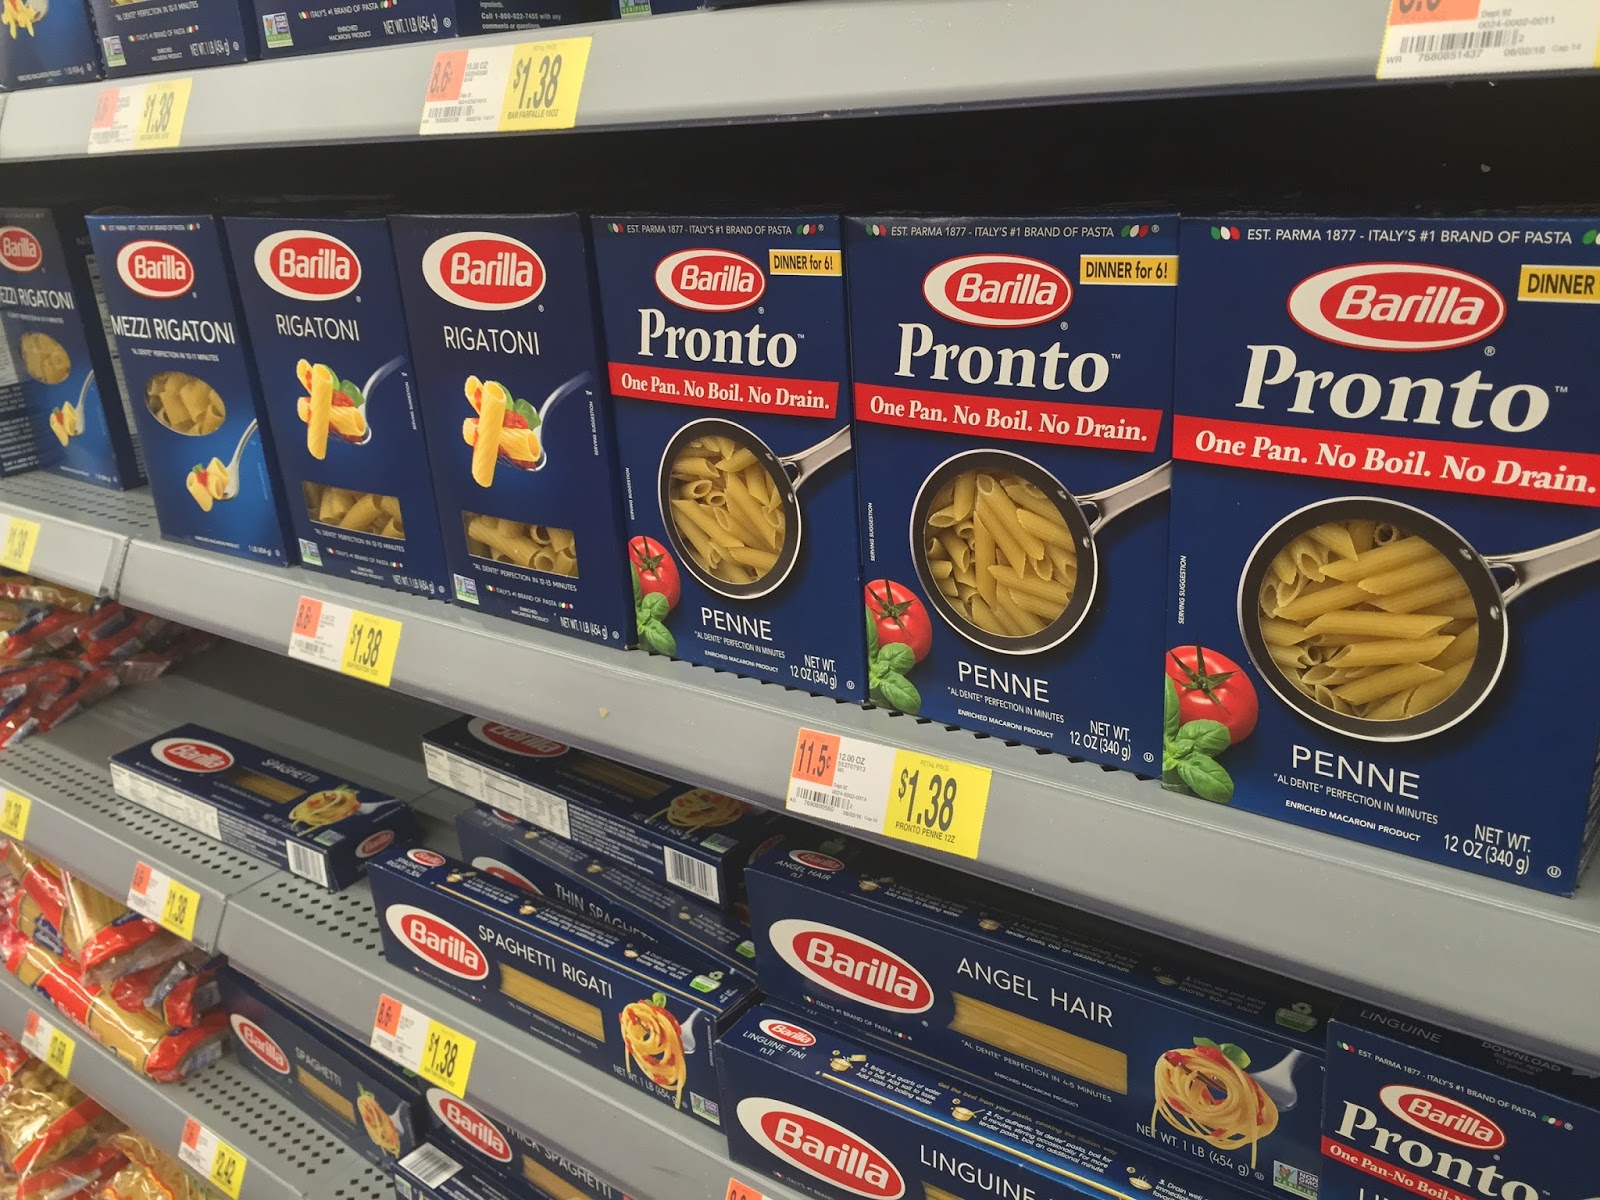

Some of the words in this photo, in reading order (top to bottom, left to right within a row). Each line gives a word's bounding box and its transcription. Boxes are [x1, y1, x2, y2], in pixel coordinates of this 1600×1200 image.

[513, 54, 562, 109] $1.38
[519, 109, 545, 119] FARFALLE
[626, 224, 641, 234] EST.
[641, 224, 667, 234] PARMA
[668, 225, 684, 234] 1877
[689, 224, 714, 235] ITALY'S
[715, 225, 724, 234] #1
[725, 225, 754, 235] BRAND
[755, 225, 766, 235] OF
[768, 225, 792, 235] PASTA
[891, 226, 910, 237] EST.
[911, 226, 943, 237] PARMA
[946, 226, 967, 237] 1877
[974, 226, 1008, 238] ITALY'S
[1009, 226, 1022, 238] #1
[1024, 226, 1062, 238] BRAND
[1064, 226, 1079, 238] OF
[1081, 226, 1114, 238] PASTA
[1247, 228, 1273, 242] EST.
[1275, 228, 1322, 241] PARMA
[1326, 228, 1356, 242] 1877
[1368, 229, 1416, 243] ITALY'S
[1419, 229, 1436, 243] #1
[1441, 230, 1494, 244] BRAND
[1498, 230, 1521, 244] OF
[1524, 231, 1572, 245] PASTA
[2, 238, 37, 258] Barilla
[279, 248, 351, 281] Barilla
[773, 255, 808, 270] DINNER
[809, 256, 822, 270] for
[824, 257, 834, 271] 6!
[134, 255, 187, 280] Barilla
[450, 251, 534, 287] Barilla
[680, 264, 756, 293] Barilla
[1086, 261, 1132, 278] DINNER
[1135, 262, 1153, 279] for
[1155, 262, 1168, 279] 6!
[1527, 273, 1595, 295] DINNER
[0, 286, 18, 305] EZZI
[18, 289, 75, 310] RIGATONI
[956, 273, 1059, 306] Barilla
[1336, 284, 1485, 326] Barilla
[110, 315, 151, 339] MEZZI
[155, 319, 236, 344] RIGATONI
[276, 313, 360, 342] RIGATONI
[443, 325, 540, 355] RIGATONI
[638, 308, 798, 368] Pronto
[894, 322, 1110, 393] Pronto
[621, 373, 648, 391] One
[650, 376, 680, 395] Pan.
[683, 380, 705, 398] No
[708, 382, 744, 402] Boil.
[748, 386, 772, 405] No
[775, 388, 830, 410] Drain.
[1235, 344, 1550, 433] Pronto
[870, 395, 905, 417] One
[909, 400, 948, 422] Pan.
[953, 405, 981, 426] No
[984, 408, 1033, 431] Boil.
[1039, 413, 1070, 435] No
[1075, 416, 1148, 442] Drain.
[1195, 430, 1246, 456] One
[1251, 436, 1308, 464] Pan.
[1315, 442, 1356, 469] No
[1362, 448, 1431, 477] Boil.
[1439, 455, 1486, 483] No
[1492, 459, 1596, 494] Drain.
[1179, 555, 1187, 597] SUGGESTION
[700, 606, 773, 642] PENNE
[1177, 598, 1185, 624] SERVING
[350, 624, 383, 668] $1.38
[957, 661, 1050, 703] PENNE
[1070, 730, 1081, 747] 12
[1083, 734, 1098, 751] OZ
[1099, 737, 1120, 757] (340
[1122, 742, 1132, 762] g)
[1090, 720, 1109, 737] NET
[1113, 725, 1131, 743] WT.
[262, 758, 321, 784] SPAGHETTI
[839, 752, 855, 763] 12.00
[856, 756, 866, 765] OZ
[920, 759, 935, 769] RETAIL
[936, 762, 950, 772] PRICE
[1291, 744, 1420, 800] PENNE
[898, 767, 957, 831] $1.38
[1326, 786, 1382, 810] PERFECTION
[1383, 799, 1395, 813] IN
[1396, 802, 1439, 826] MINUTES
[895, 821, 921, 835] PRONTO
[922, 828, 943, 841] PENNE
[944, 834, 956, 844] 12Z
[1285, 799, 1327, 819] ENRICHED
[1328, 811, 1376, 832] MACARONI
[1378, 823, 1421, 843] PRODUCT
[1475, 824, 1503, 848] NET
[1507, 831, 1531, 853] WT.
[775, 859, 806, 874] ANGEL
[808, 868, 832, 881] HAIR
[1444, 834, 1458, 853] 12
[1462, 839, 1483, 860] OZ
[1485, 843, 1514, 870] (340
[1516, 854, 1530, 876] g)
[555, 883, 584, 911] THIN
[409, 918, 480, 971] Barilla
[478, 924, 556, 973] SPAGHETTI
[562, 962, 613, 1000] RIGATI
[806, 937, 919, 1002] Barilla
[956, 957, 1039, 1002] ANGEL
[1050, 987, 1113, 1028] HAIR
[770, 1023, 812, 1045] Barilla
[1360, 1009, 1442, 1044] LINGUINE
[244, 1027, 285, 1065] Barilla
[428, 1032, 458, 1078] $1.38
[742, 1030, 785, 1052] LINGUINE
[786, 1046, 807, 1060] FINI
[295, 1046, 342, 1088] SPAGHETTI
[1003, 1055, 1049, 1079] PERFECTION
[1077, 1084, 1112, 1103] MINUTES
[1358, 1049, 1374, 1060] EST.
[1374, 1055, 1402, 1070] PARMA
[1403, 1065, 1421, 1077] 1877
[1426, 1074, 1454, 1089] ITALY'S
[1455, 1085, 1465, 1093] #1
[1467, 1088, 1496, 1104] BRAND
[1497, 1099, 1510, 1109] OF
[1511, 1104, 1538, 1119] PASTA
[446, 1102, 504, 1154] Barilla
[1407, 1097, 1494, 1143] Barilla
[774, 1117, 890, 1189] Barilla
[1136, 1122, 1161, 1139] NET
[1161, 1131, 1180, 1149] WT.
[1182, 1140, 1187, 1152] 1
[1192, 1143, 1205, 1158] LB
[1209, 1150, 1235, 1171] (454
[1237, 1163, 1250, 1177] g)
[1329, 1145, 1359, 1165] One
[1361, 1158, 1415, 1187] Pan-No
[1335, 1100, 1539, 1200] Pronto
[920, 1144, 1037, 1200] LINGUINE
[1298, 1172, 1319, 1183] NON
[1298, 1177, 1319, 1189] GMO
